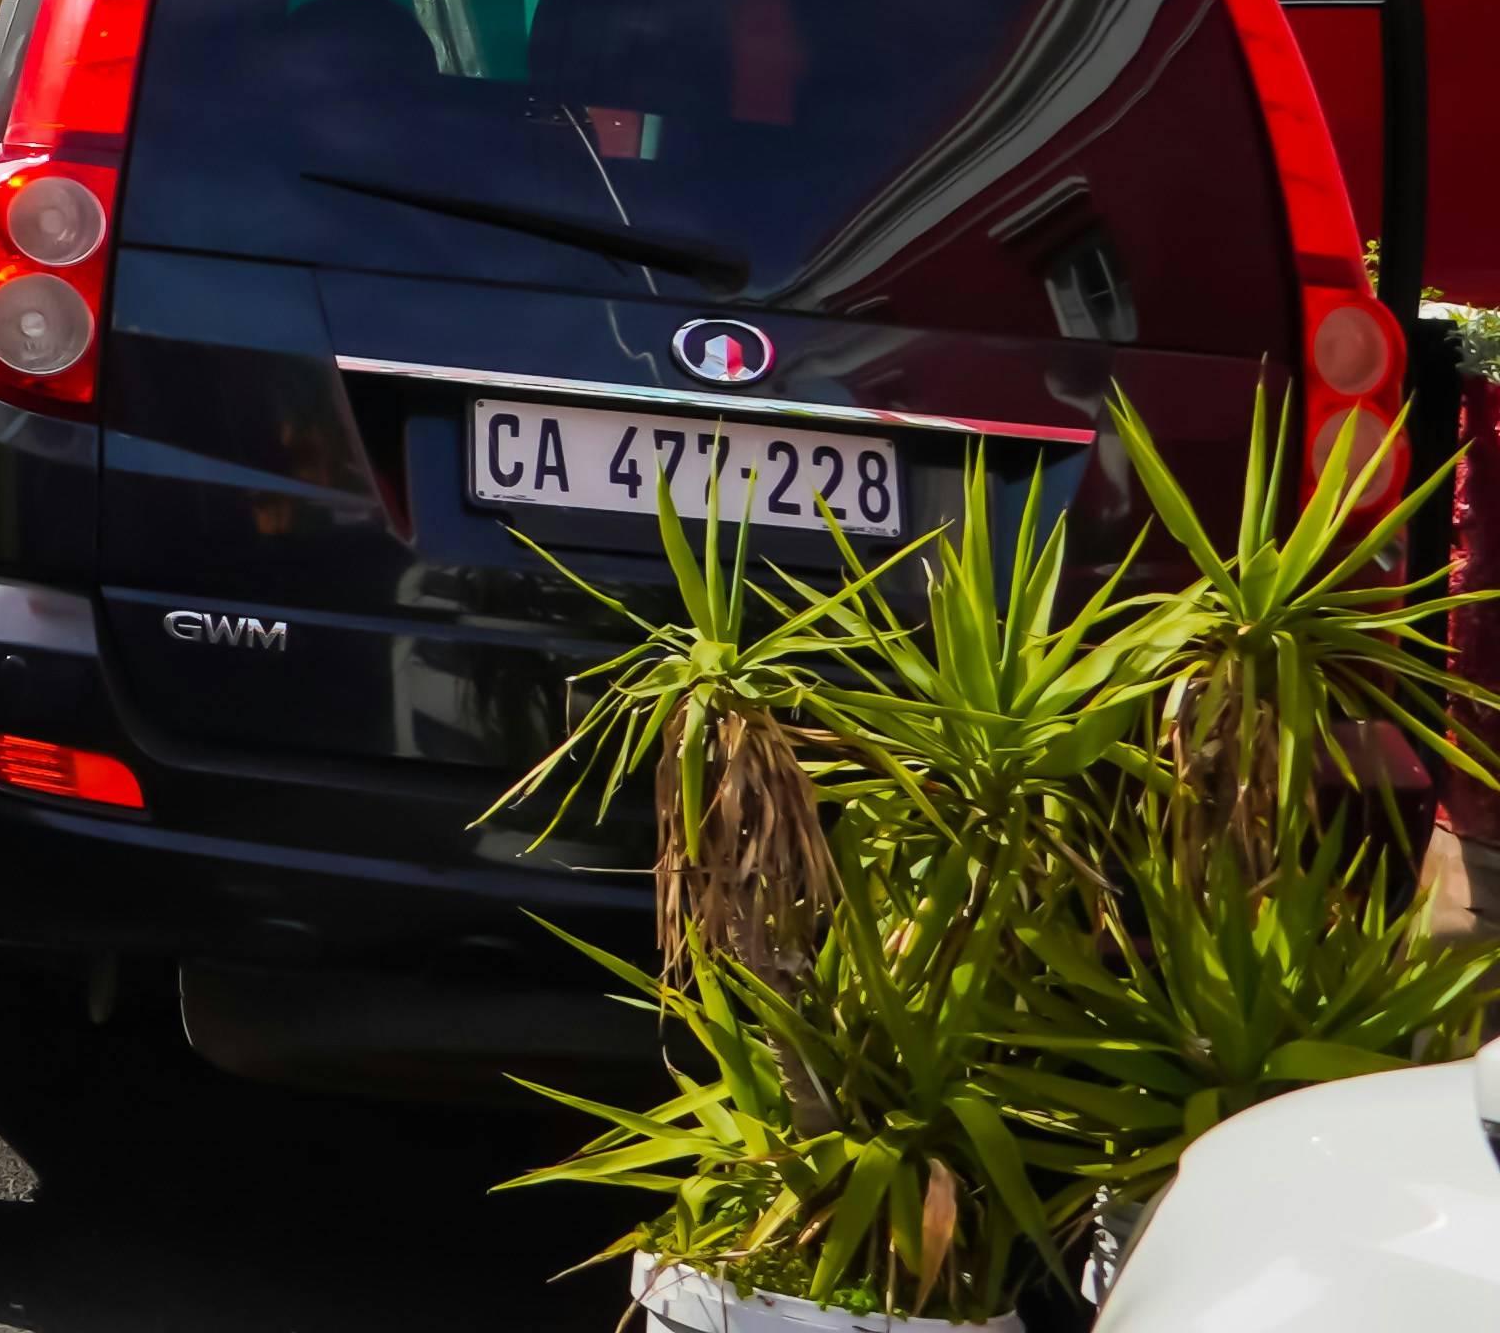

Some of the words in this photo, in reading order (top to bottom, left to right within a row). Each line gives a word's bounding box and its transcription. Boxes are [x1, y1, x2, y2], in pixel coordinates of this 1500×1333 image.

[487, 412, 570, 493] CA
[609, 425, 892, 524] 477-228
[163, 610, 287, 652] GWM
